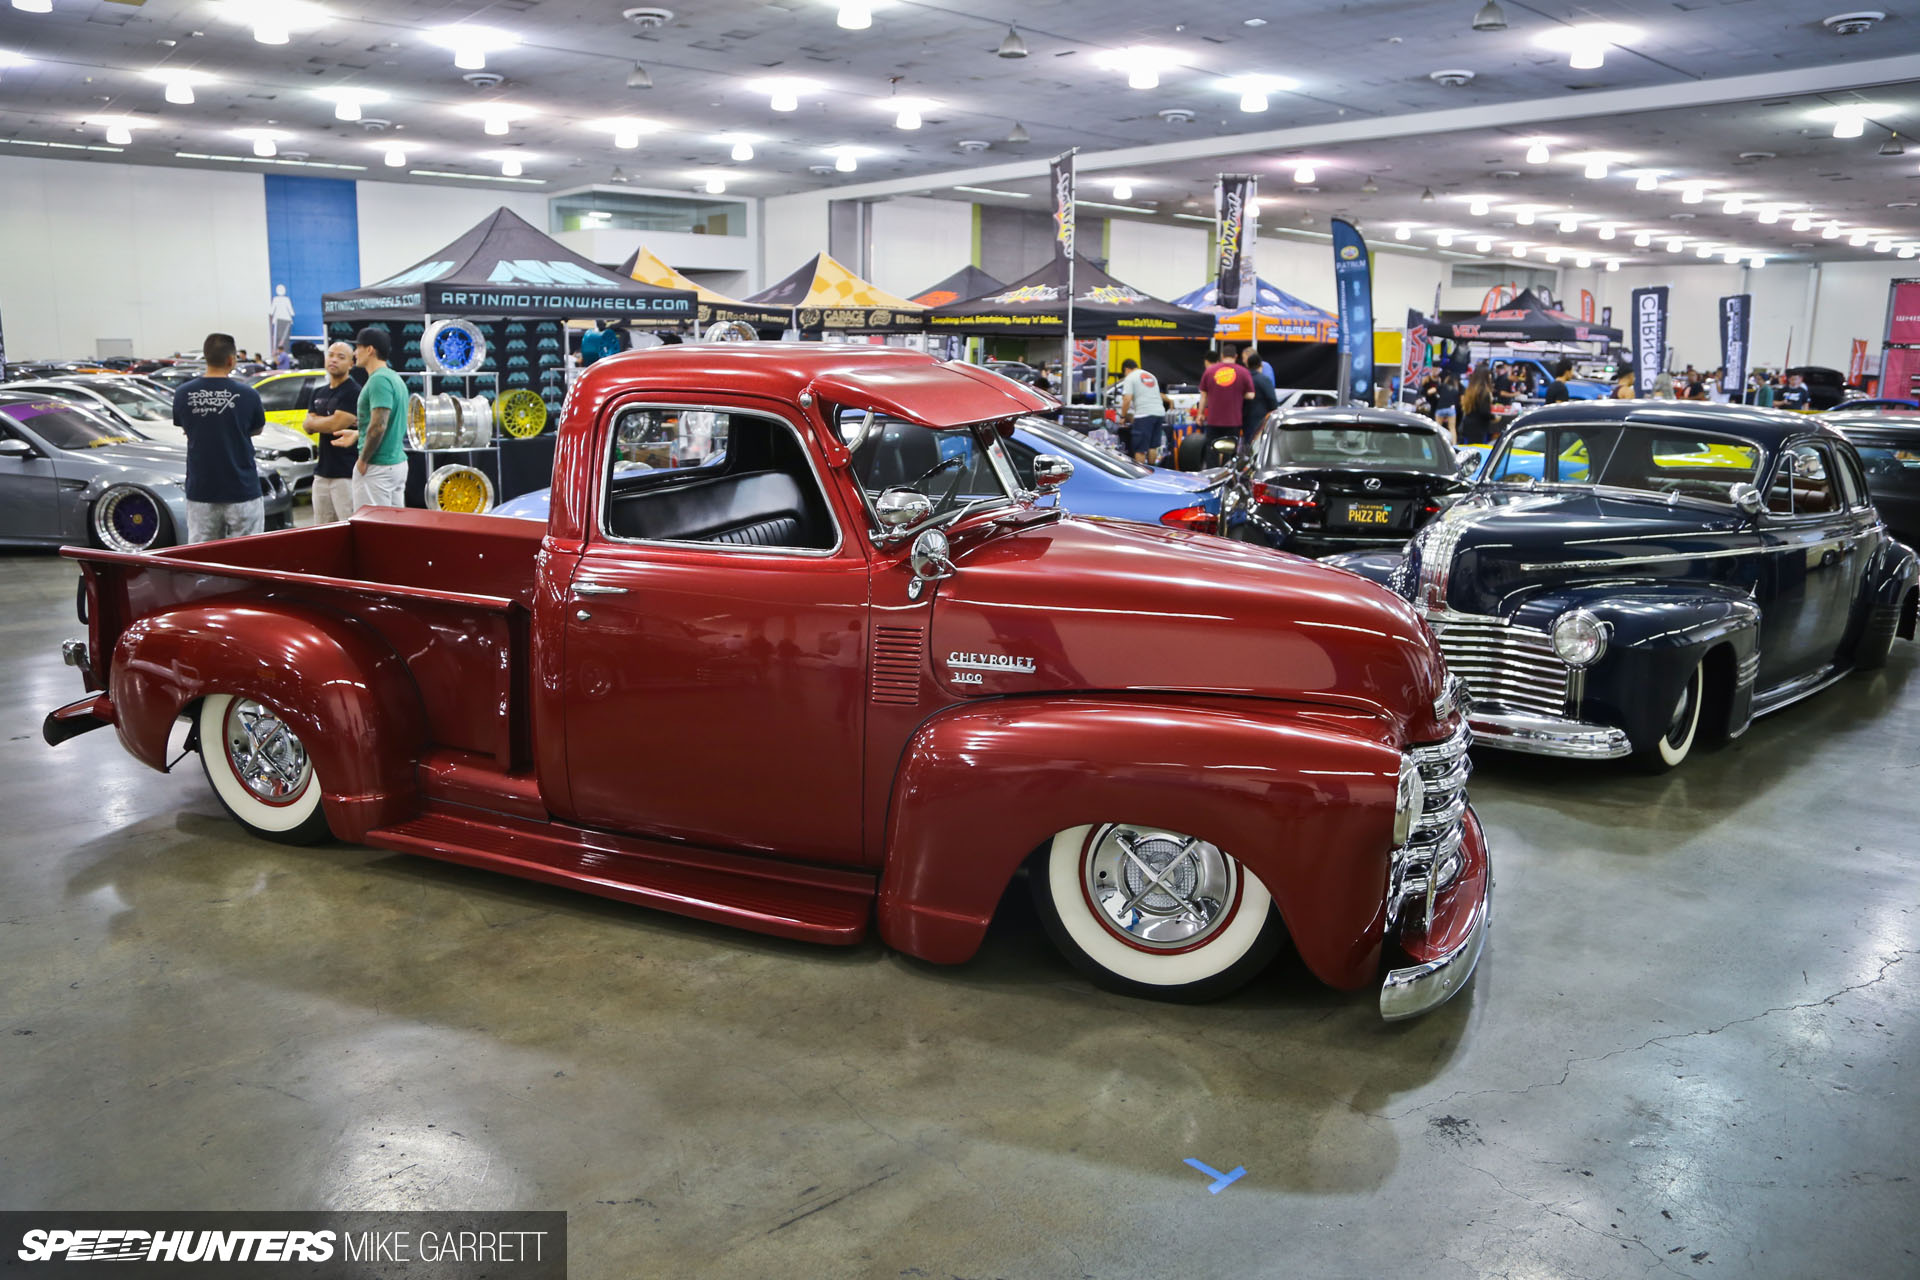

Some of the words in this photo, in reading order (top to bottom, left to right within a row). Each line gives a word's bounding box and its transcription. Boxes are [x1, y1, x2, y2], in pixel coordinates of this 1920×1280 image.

[441, 291, 689, 311] ARTINMOTIONWHEELS.COM
[726, 311, 759, 322] Rocket
[761, 313, 790, 325] Bunny
[823, 310, 865, 321] GARAGE
[1375, 510, 1389, 524] RC
[949, 651, 1035, 669] CHEVROLET
[953, 671, 983, 682] 3100
